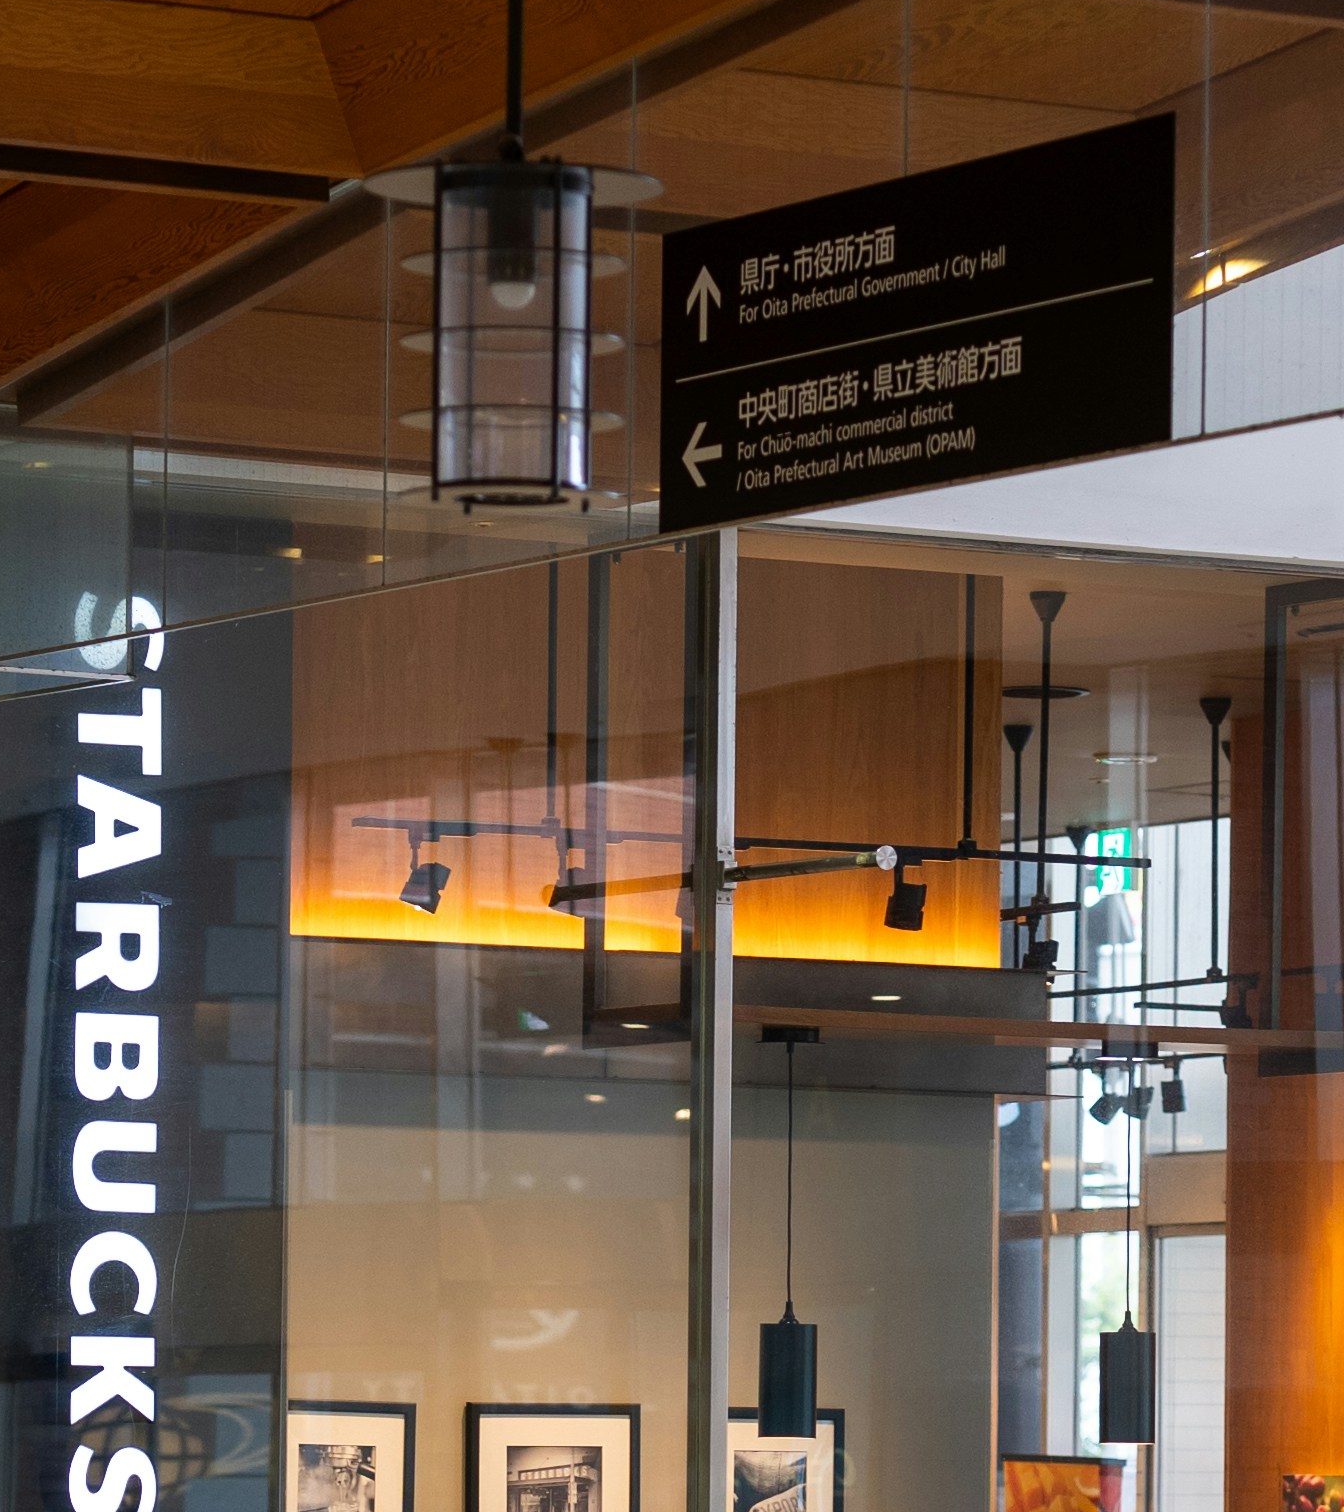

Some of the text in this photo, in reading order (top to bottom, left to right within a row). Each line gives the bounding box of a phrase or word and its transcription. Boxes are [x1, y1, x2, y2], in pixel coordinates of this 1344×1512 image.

[739, 304, 758, 324] For
[762, 298, 788, 320] Oita
[791, 278, 857, 314] Prefectural
[862, 262, 940, 298] Government
[951, 253, 976, 279] City
[981, 244, 1006, 272] Hall
[740, 225, 896, 295] 県庁・市役所方面
[738, 336, 1022, 428] 中央町商店街・県立美術館方面
[737, 401, 954, 461] For Chūō-machi commercial district
[744, 467, 770, 491] Oita
[774, 450, 840, 485] Prefectural
[843, 451, 864, 471] Art
[868, 440, 922, 467] Museum
[926, 426, 976, 457] (OPAM)
